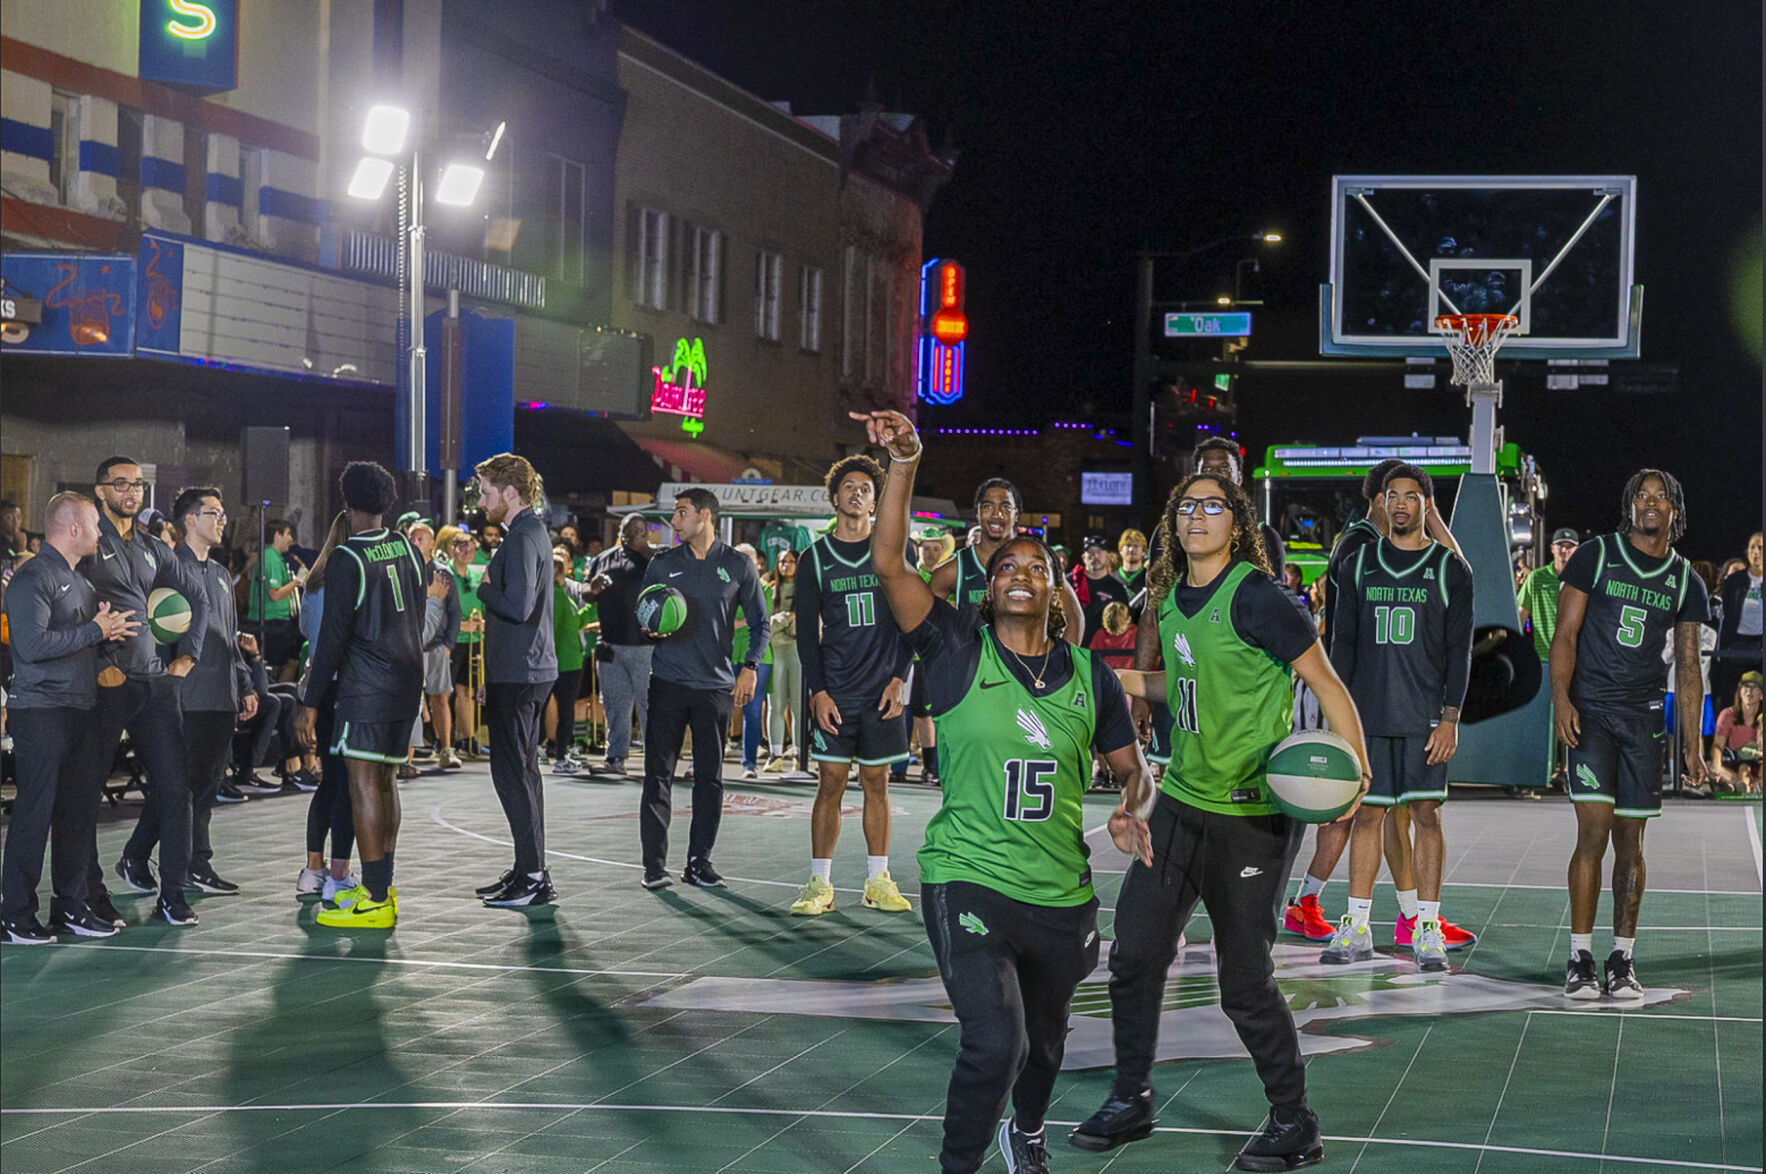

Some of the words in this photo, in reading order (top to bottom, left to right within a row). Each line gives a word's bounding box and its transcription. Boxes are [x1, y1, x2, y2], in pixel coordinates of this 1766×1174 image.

[1194, 316, 1220, 332] Oak
[386, 564, 405, 612] 1
[830, 576, 857, 592] NORTH
[858, 574, 880, 588] TEXA
[1366, 587, 1394, 602] NORTH
[1396, 587, 1427, 603] TEXAS
[1605, 579, 1639, 602] NORTH
[1641, 588, 1672, 611] TEXAS
[845, 592, 875, 627] 11
[1375, 606, 1415, 644] 10
[1616, 604, 1648, 648] 5
[1177, 677, 1199, 733] 11
[1004, 758, 1058, 822] 15
